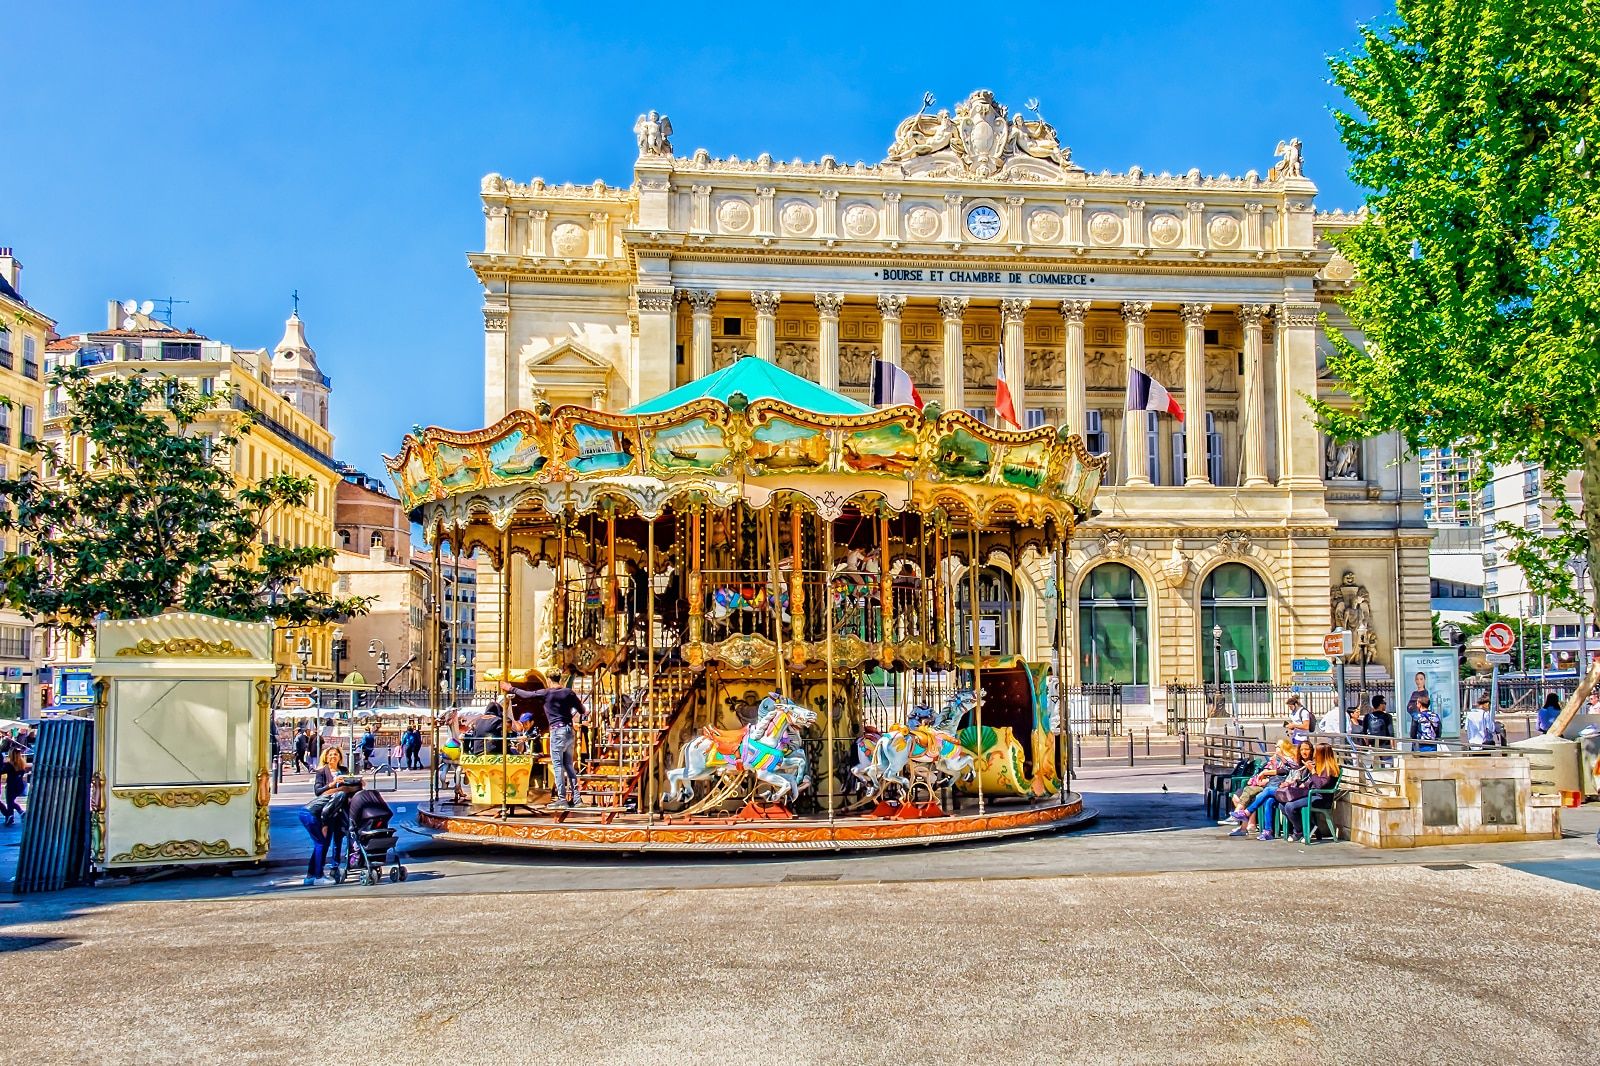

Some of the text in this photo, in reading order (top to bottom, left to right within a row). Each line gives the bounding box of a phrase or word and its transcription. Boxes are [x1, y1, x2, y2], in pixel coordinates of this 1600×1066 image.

[883, 269, 1087, 285] BOURSE ET CHAMBRE DE COMMERCE
